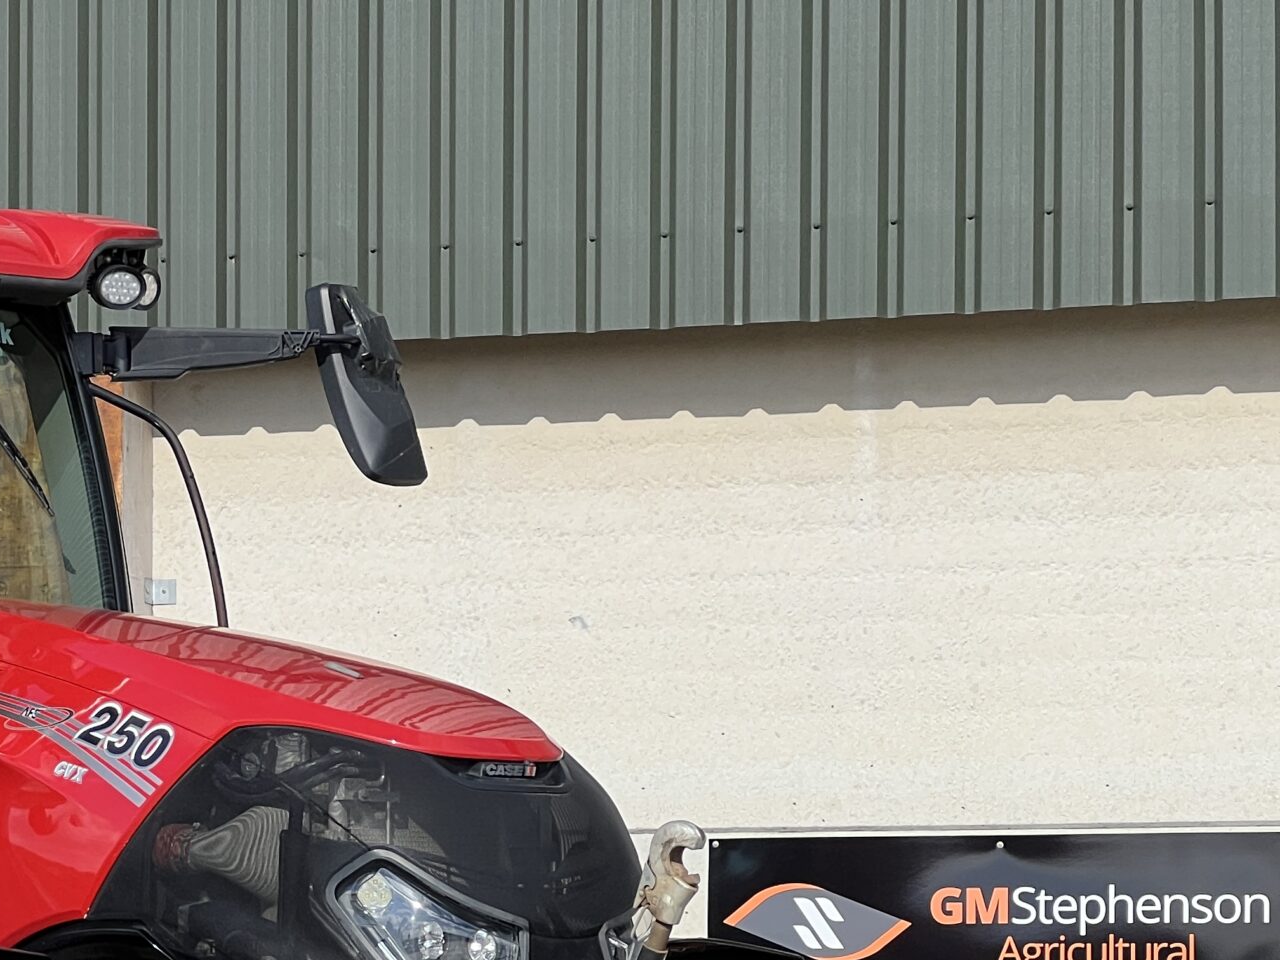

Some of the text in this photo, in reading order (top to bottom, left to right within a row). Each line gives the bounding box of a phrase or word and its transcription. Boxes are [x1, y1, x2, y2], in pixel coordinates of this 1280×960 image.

[72, 701, 175, 771] 250
[53, 760, 89, 785] CVX
[929, 884, 1271, 936] GMStephenson
